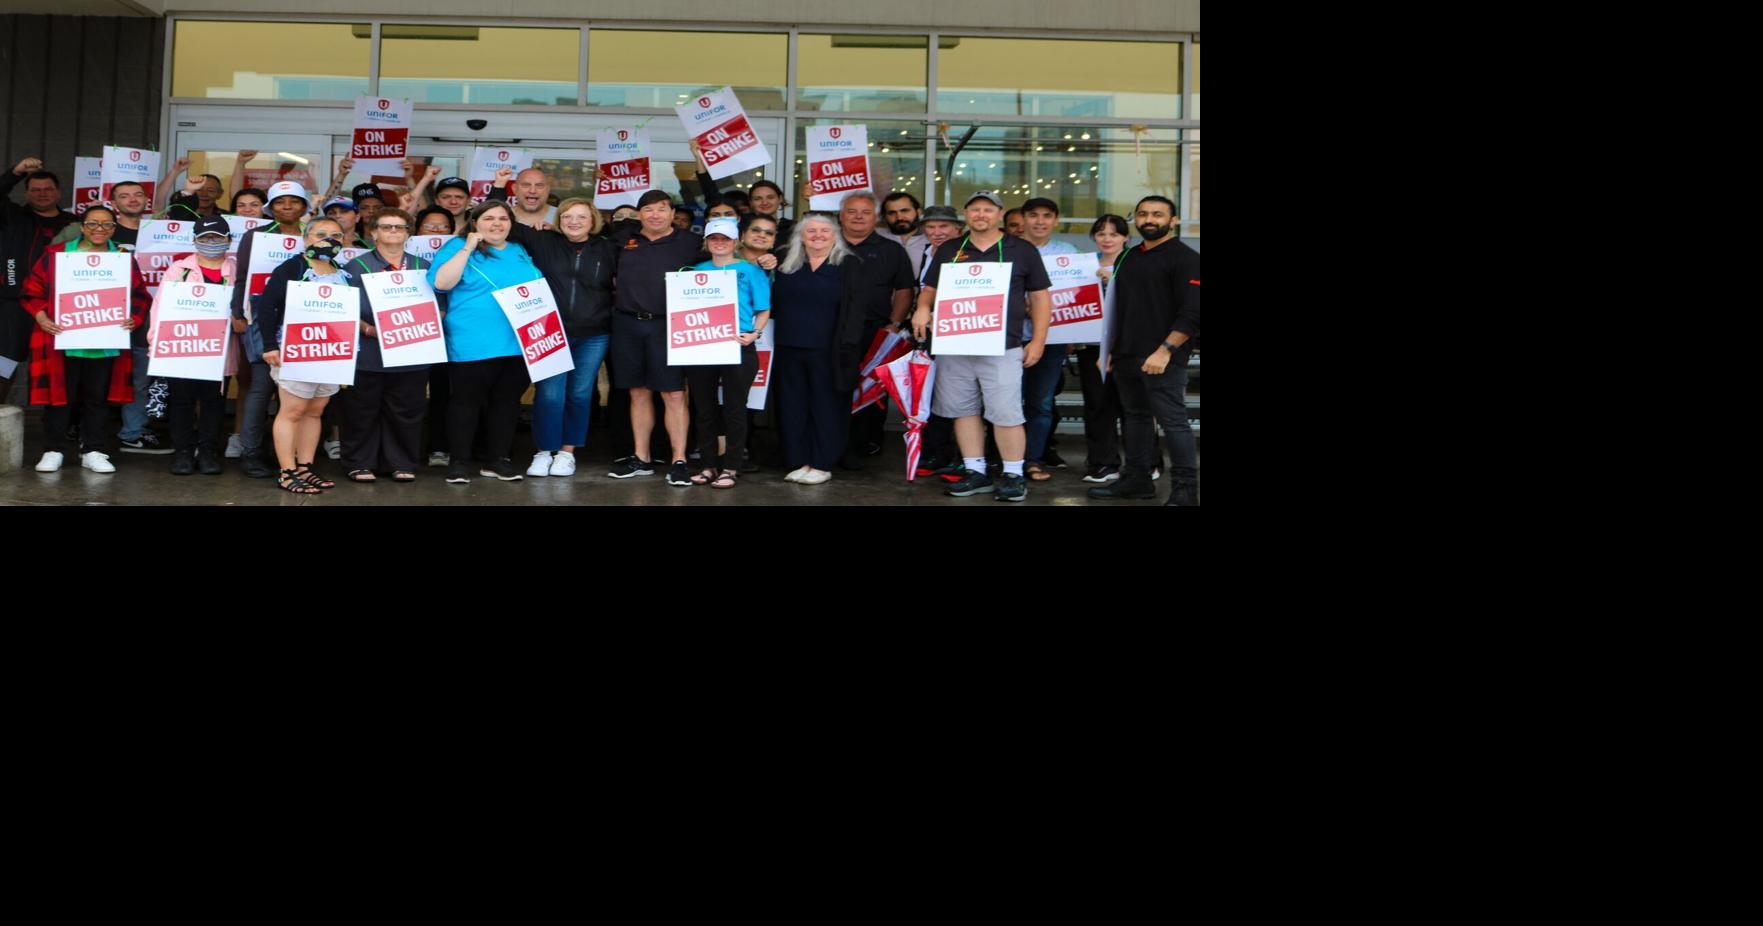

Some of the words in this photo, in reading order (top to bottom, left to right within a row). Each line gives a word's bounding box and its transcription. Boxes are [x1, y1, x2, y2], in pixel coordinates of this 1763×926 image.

[364, 131, 385, 143] ON
[708, 128, 731, 145] ON
[353, 144, 404, 156] STRIKE
[704, 131, 755, 162] STRIKE
[610, 163, 630, 177] ON
[821, 162, 844, 176] ON
[600, 175, 648, 192] STRIKE
[812, 173, 866, 192] STRIKE
[151, 255, 174, 268] ON
[73, 293, 100, 309] ON
[1052, 291, 1076, 306] ON
[952, 301, 977, 315] ON
[60, 306, 125, 327] STRIKE
[390, 310, 415, 326] ON
[684, 311, 710, 327] ON
[938, 313, 1000, 333] STRIKE
[173, 323, 199, 338] ON
[301, 326, 328, 341] ON
[382, 321, 439, 345] STRIKE
[527, 322, 546, 340] ON
[672, 324, 734, 345] STRIKE
[157, 338, 221, 354] STRIKE
[286, 341, 351, 359] STRIKE
[524, 330, 564, 361] STRIKE
